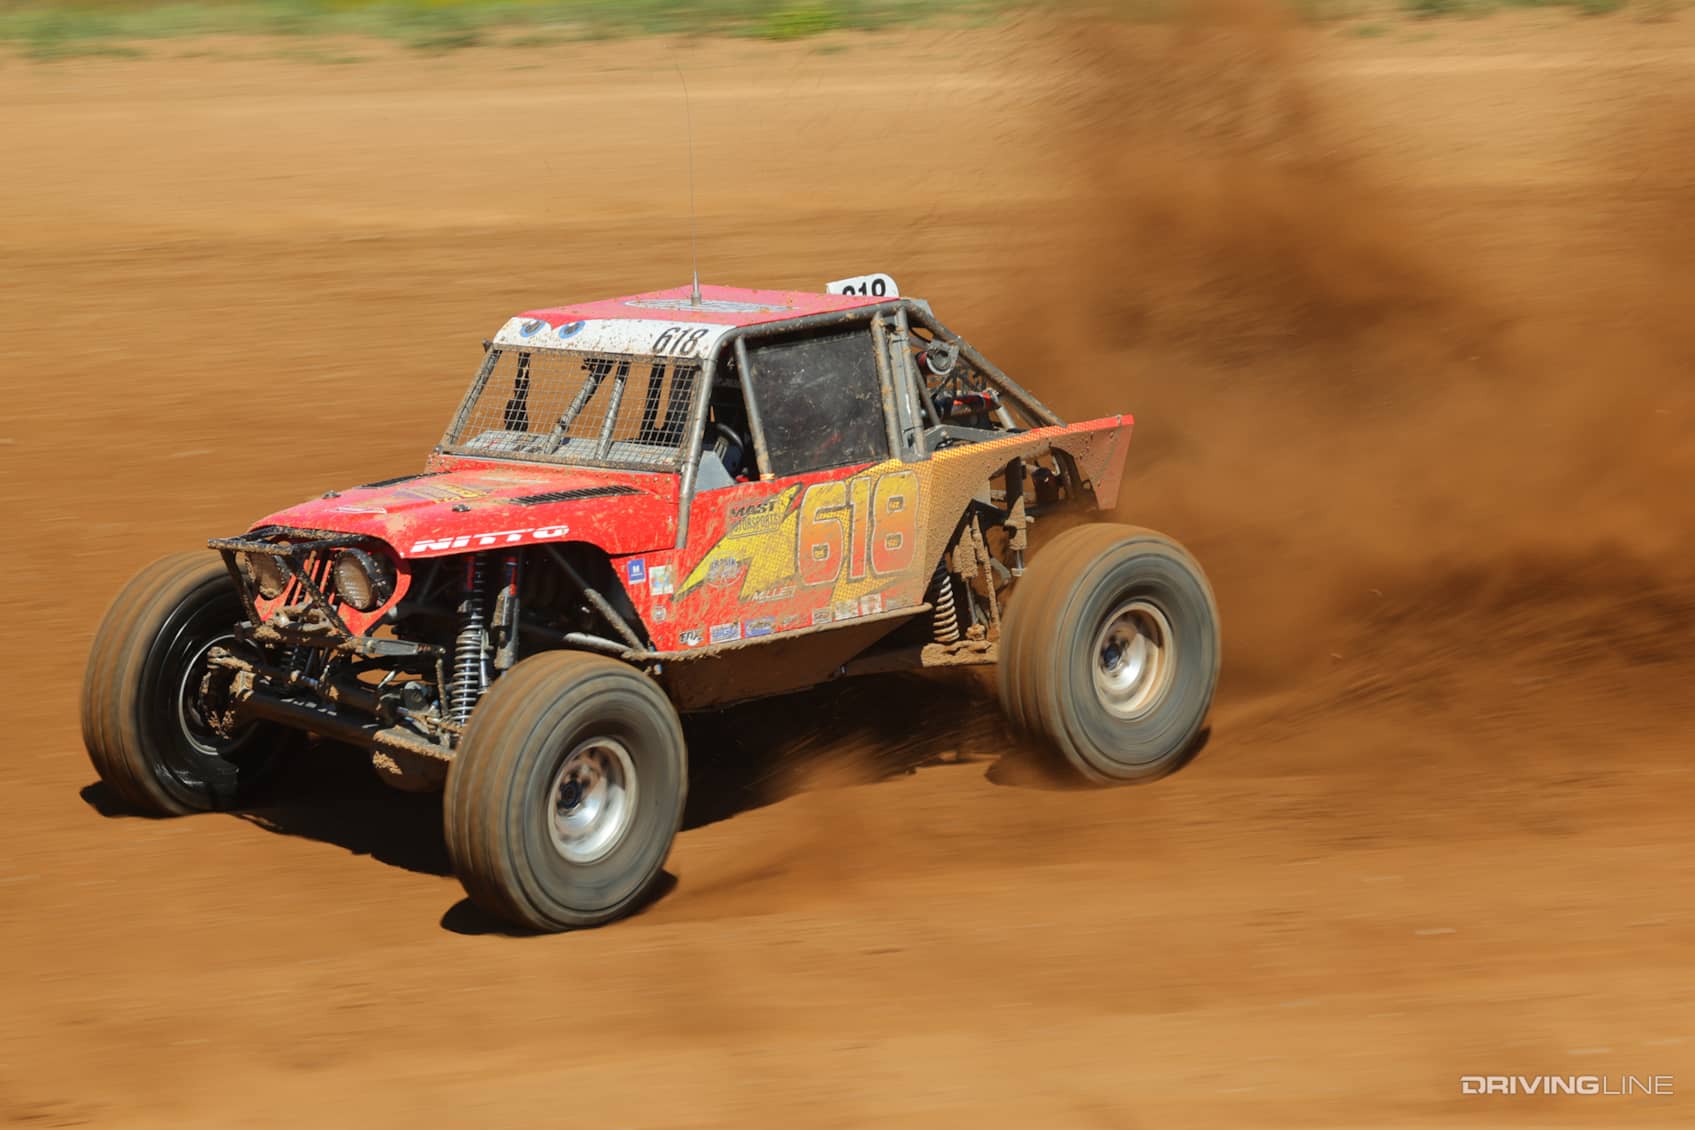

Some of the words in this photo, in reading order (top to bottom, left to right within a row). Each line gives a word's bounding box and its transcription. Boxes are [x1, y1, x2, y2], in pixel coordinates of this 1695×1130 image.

[652, 326, 709, 356] 618
[410, 525, 568, 553] NITTO
[798, 470, 919, 585] 618
